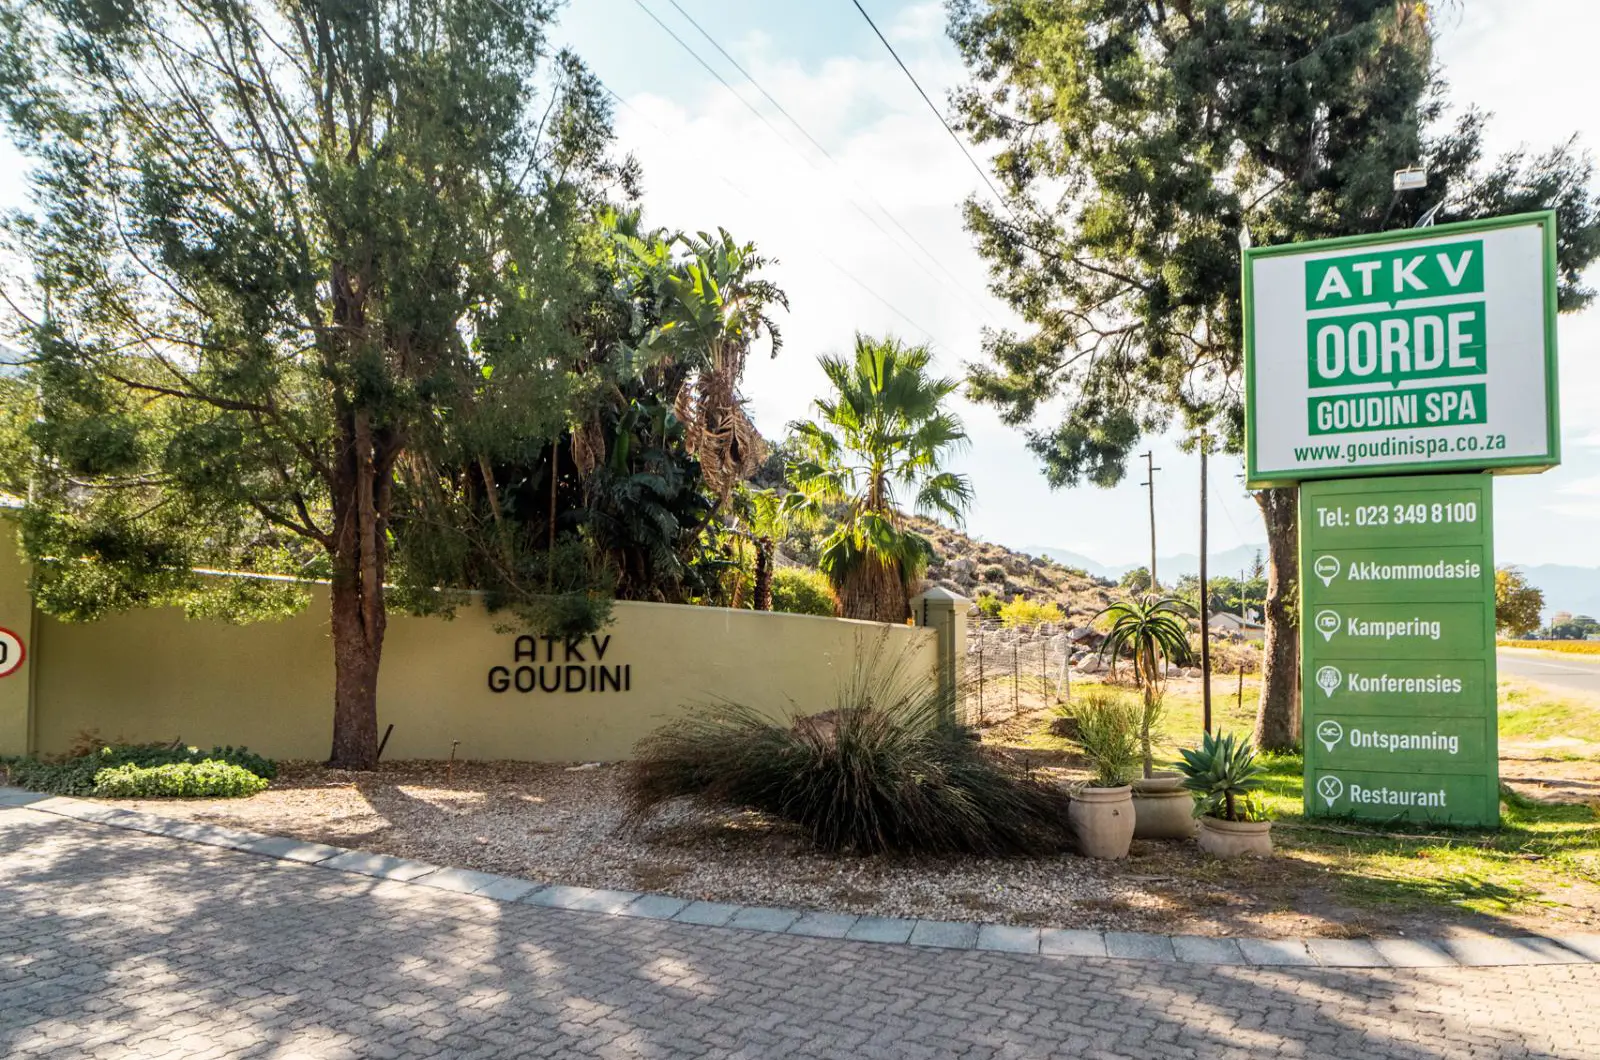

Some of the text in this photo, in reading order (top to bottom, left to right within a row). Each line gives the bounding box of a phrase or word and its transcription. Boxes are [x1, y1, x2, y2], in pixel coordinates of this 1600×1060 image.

[1315, 250, 1474, 302] ATKV
[1316, 310, 1477, 380] OORDE
[1317, 390, 1477, 431] GOUDINI SPA
[1294, 433, 1506, 463] www.goudinispa.co.za
[1316, 502, 1477, 527] Tel: 023 349 8100
[1347, 559, 1481, 581] Akkommodasie
[1347, 617, 1441, 640] Kampering
[514, 634, 611, 662] ATKV
[488, 664, 631, 693] GOUDINI
[1348, 673, 1462, 693] Konferensies
[1350, 728, 1459, 754] Ontspanning
[1350, 784, 1447, 807] Restaurant
